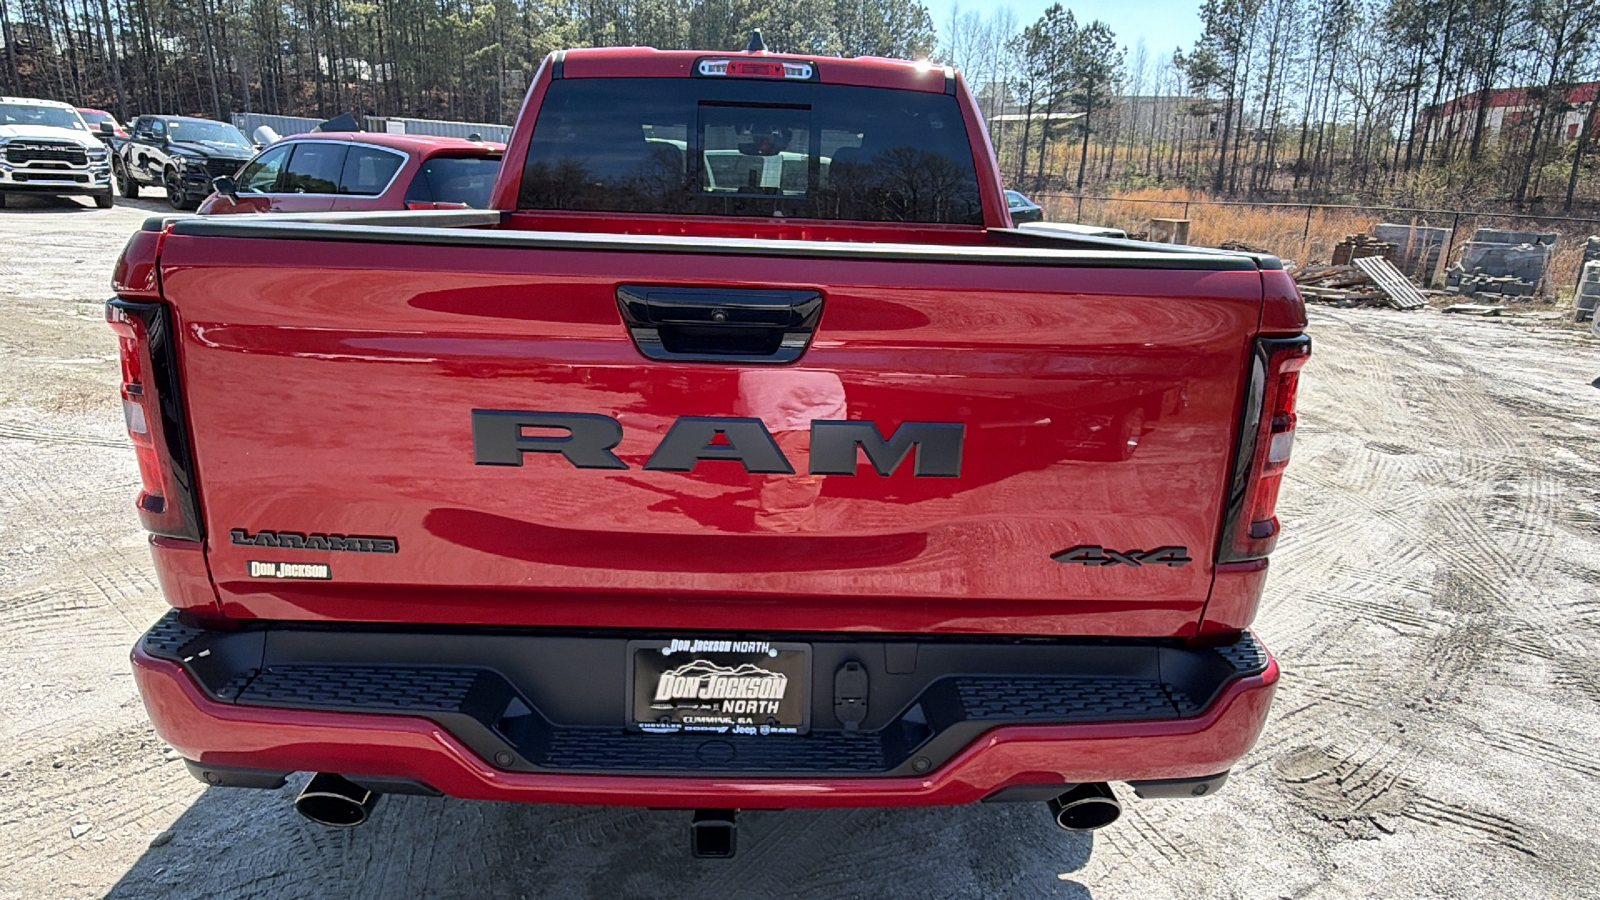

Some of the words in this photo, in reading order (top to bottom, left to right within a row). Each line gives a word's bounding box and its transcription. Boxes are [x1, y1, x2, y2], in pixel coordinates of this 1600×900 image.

[471, 408, 964, 478] RAM
[230, 528, 398, 554] LARAMIE
[732, 641, 770, 654] NORTH
[722, 700, 779, 714] NORTH
[732, 725, 757, 735] Jeep
